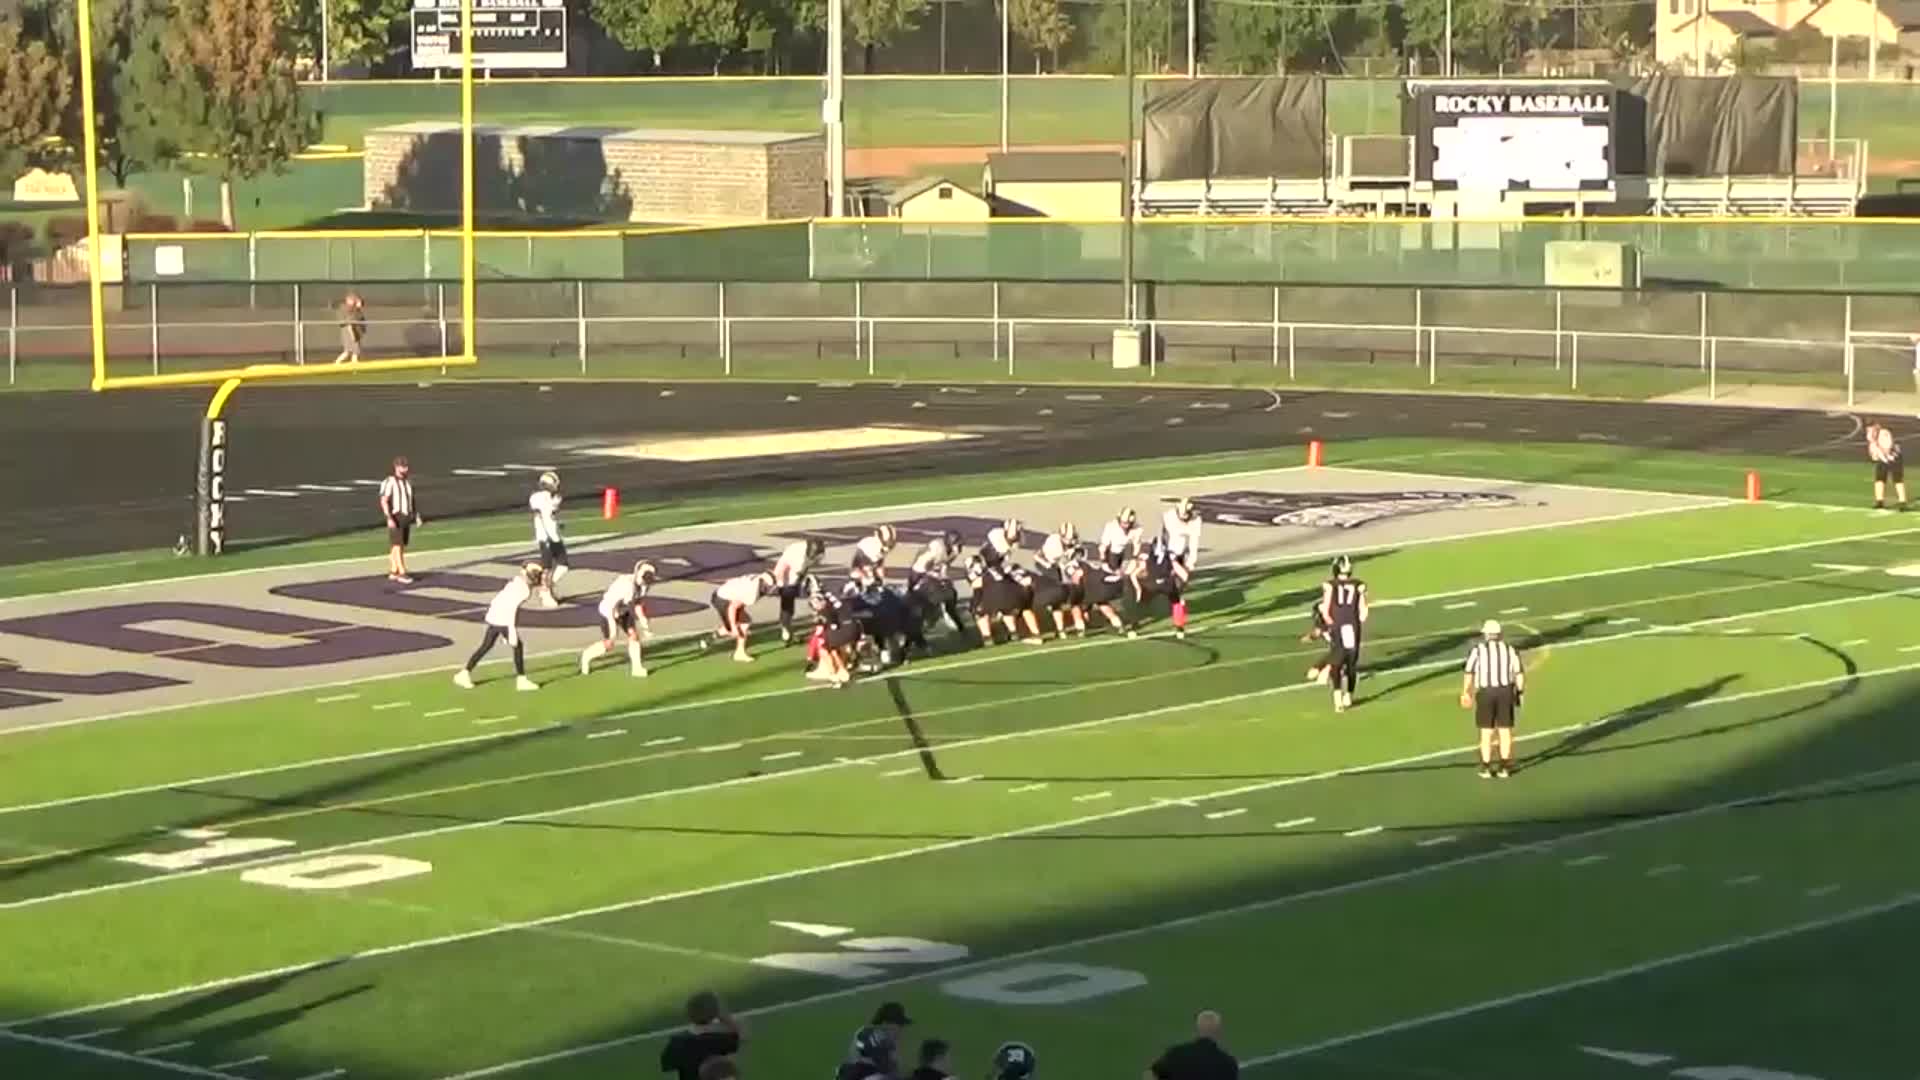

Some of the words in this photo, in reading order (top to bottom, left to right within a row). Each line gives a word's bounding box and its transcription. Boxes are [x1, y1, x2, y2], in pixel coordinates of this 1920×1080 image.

[1435, 95, 1506, 113] ROCKY
[1509, 95, 1609, 113] BASEBALL
[210, 420, 225, 555] ROCKY
[1338, 584, 1355, 605] 17
[113, 836, 433, 889] 10
[749, 936, 1148, 1004] 20
